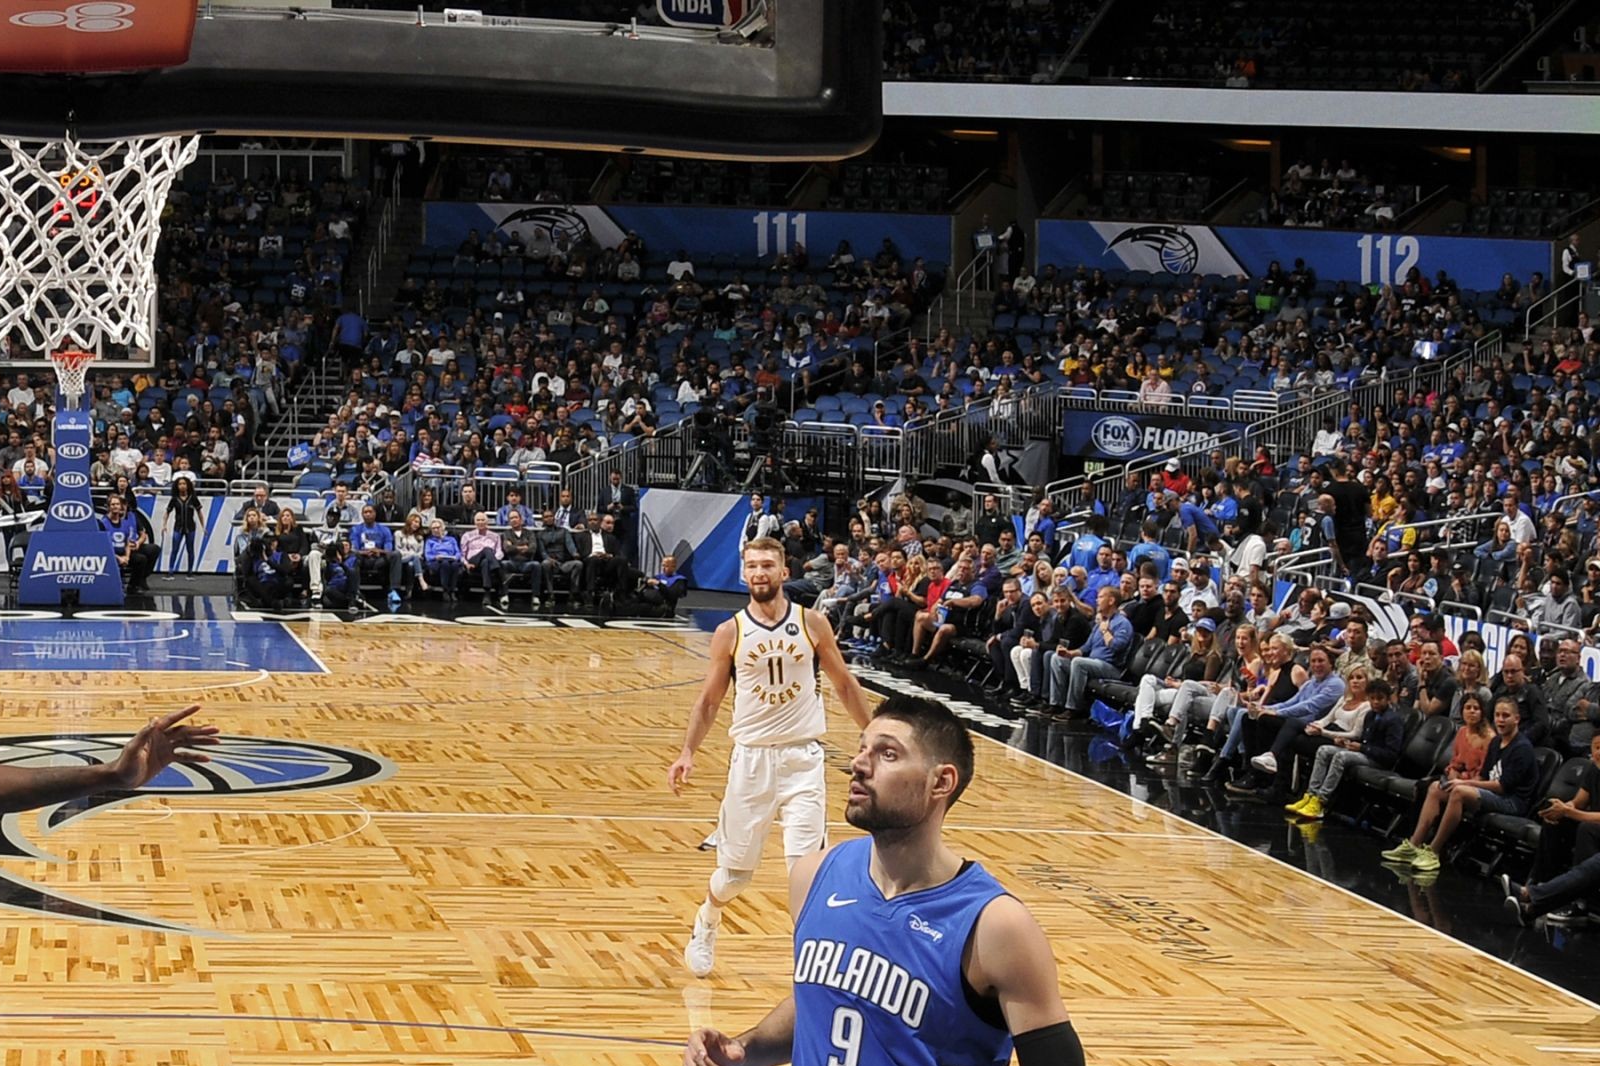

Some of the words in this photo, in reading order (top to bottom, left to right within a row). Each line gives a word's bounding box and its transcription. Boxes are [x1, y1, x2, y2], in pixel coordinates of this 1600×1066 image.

[753, 211, 807, 257] 111
[1357, 234, 1419, 286] 112
[1102, 423, 1131, 441] FOX
[1102, 439, 1132, 449] SPORTS
[63, 446, 83, 456] KIA
[62, 474, 83, 484] KIA
[57, 505, 87, 518] KIA
[32, 551, 108, 575] Amway
[56, 574, 96, 585] CENTER
[744, 639, 804, 668] INDIANA
[767, 656, 784, 686] 11
[752, 681, 802, 705] PACERS
[908, 914, 944, 943] Disney
[793, 939, 931, 1030] ORLANDO
